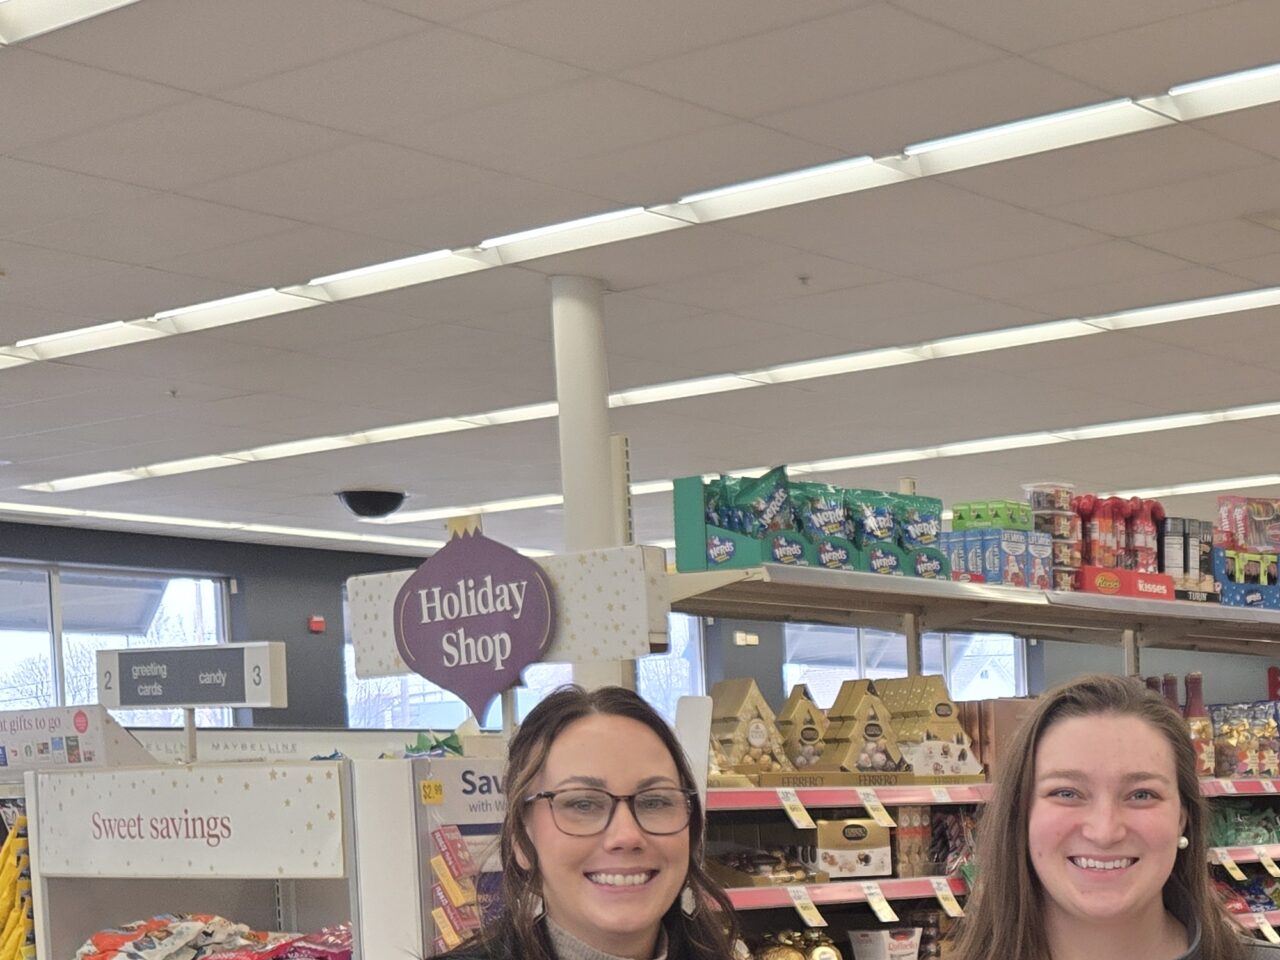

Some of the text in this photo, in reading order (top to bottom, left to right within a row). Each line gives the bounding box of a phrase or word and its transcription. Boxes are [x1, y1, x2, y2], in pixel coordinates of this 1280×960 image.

[418, 577, 528, 626] Holiday
[441, 628, 512, 672] Shop
[104, 671, 112, 690] 2
[131, 662, 227, 686] greeting candy
[252, 665, 262, 686] 3
[137, 683, 163, 696] cards
[9, 716, 32, 735] gifts
[35, 716, 47, 728] to
[49, 717, 61, 731] go
[211, 743, 298, 753] MAYBELLINE
[461, 770, 506, 796] Sav
[858, 775, 898, 786] FERRERO
[468, 800, 493, 813] with
[92, 808, 232, 847] Sweet savings
